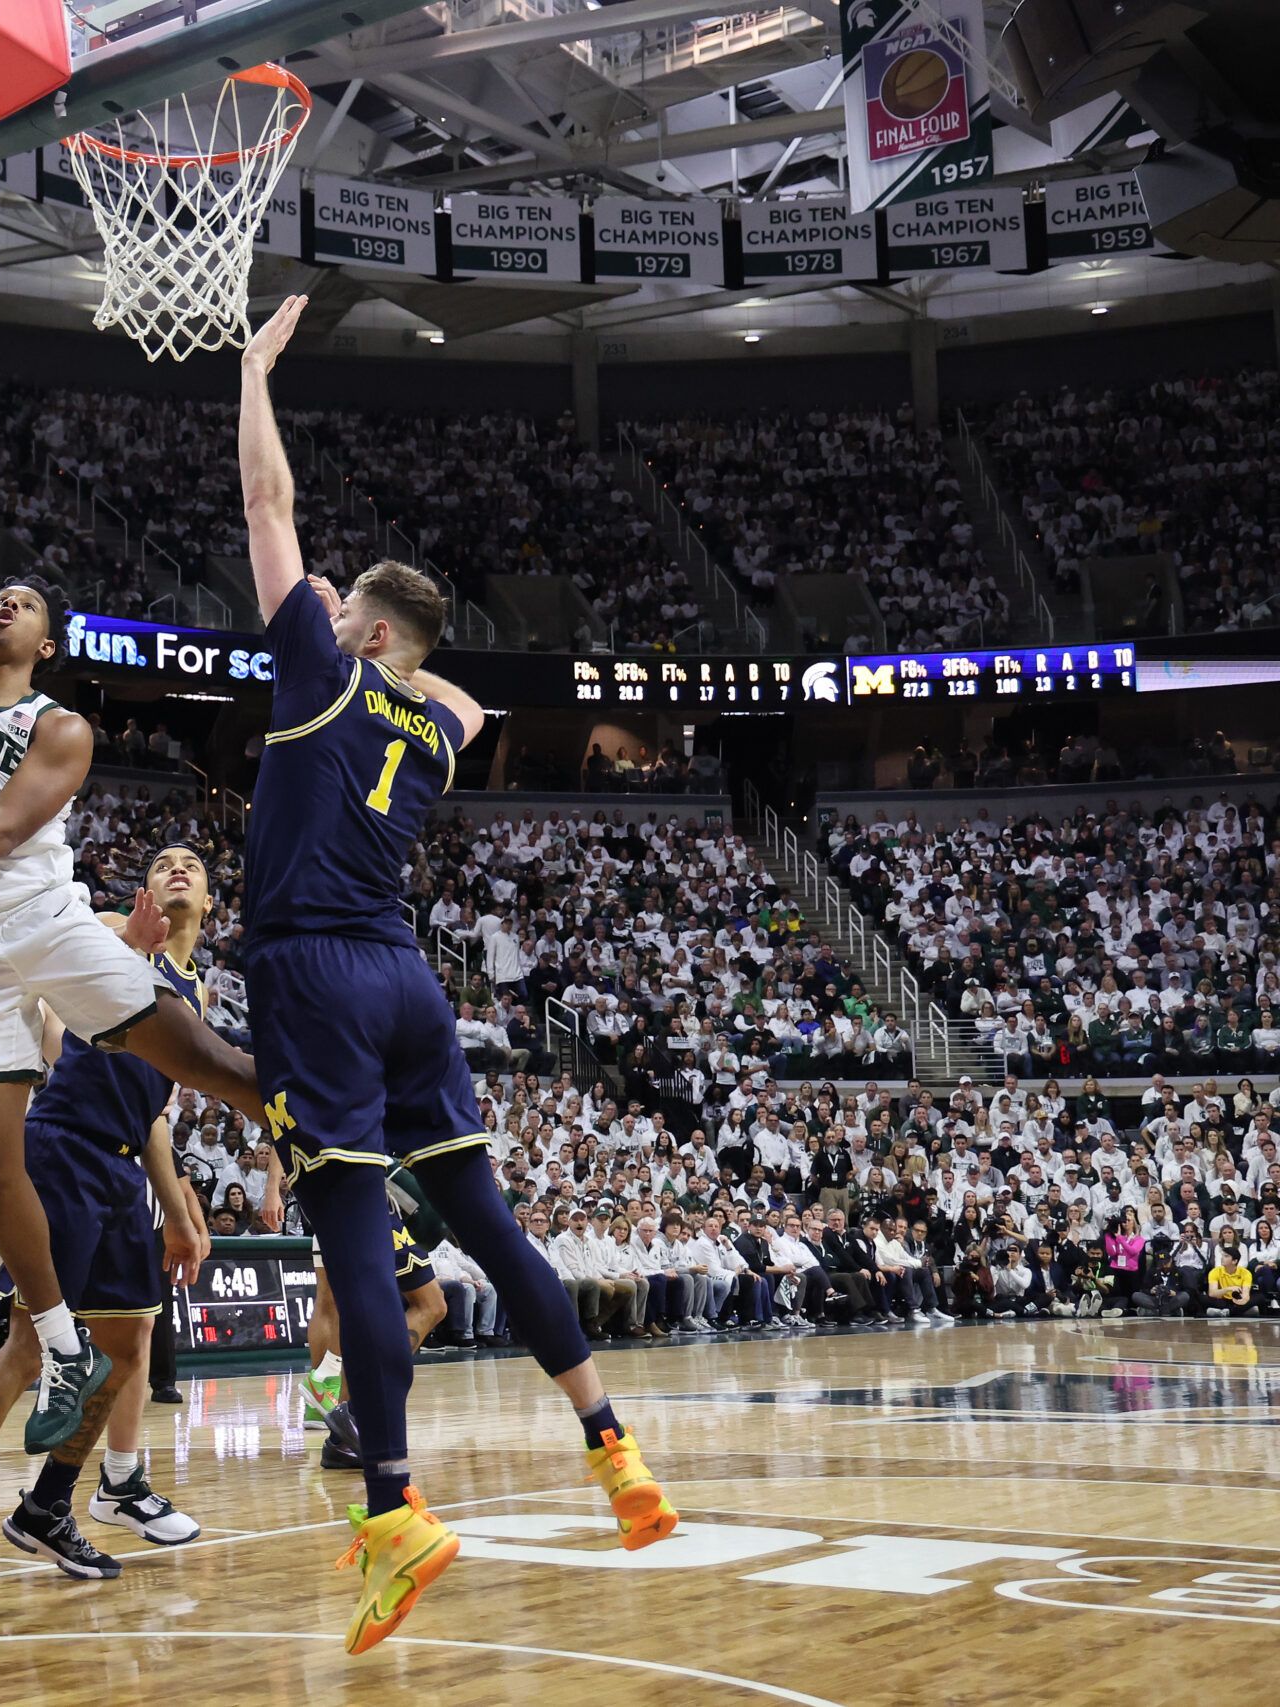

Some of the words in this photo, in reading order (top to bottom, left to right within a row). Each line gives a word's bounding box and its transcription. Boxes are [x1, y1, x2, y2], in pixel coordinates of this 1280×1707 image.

[876, 123, 916, 149] FINAL
[920, 111, 960, 137] FOUR
[931, 156, 989, 186] 1957
[340, 188, 370, 206] BIG
[375, 194, 409, 213] TEN
[1076, 184, 1110, 203] BIG
[1117, 180, 1140, 197] TE
[478, 204, 509, 220] BIG
[515, 205, 552, 221] TEN
[621, 209, 652, 225] BIG
[658, 210, 694, 226] TEN
[770, 208, 802, 224] BIG
[808, 206, 846, 222] TEN
[915, 201, 949, 217] BIG
[955, 198, 993, 214] TEN
[319, 206, 431, 235] CHAMPIONS
[892, 216, 1020, 238] CHAMPIONS
[456, 222, 576, 242] CHAMPIONS
[599, 228, 719, 246] CHAMPIONS
[747, 224, 871, 245] CHAMPIONS
[1091, 228, 1147, 249] 1959
[352, 238, 399, 260] 1998
[490, 250, 542, 269] 1990
[931, 245, 983, 265] 1967
[635, 256, 684, 274] 1979
[784, 253, 835, 272] 1978
[67, 615, 147, 667] fun.
[157, 632, 220, 675] For
[574, 662, 599, 681] FG%
[614, 663, 648, 682] 3FG%
[662, 663, 687, 682] FT%
[701, 664, 710, 681] R
[725, 664, 735, 681] A
[749, 664, 758, 681] B
[773, 664, 790, 681] TO
[901, 660, 927, 678] FG%
[942, 658, 978, 677] 3FG%
[994, 655, 1020, 675] FT%
[1037, 654, 1046, 672] R
[1062, 653, 1072, 671] A
[1088, 651, 1098, 669] B
[1114, 648, 1132, 667] TO
[853, 665, 895, 695] M
[903, 682, 929, 697] 27.3
[948, 680, 976, 695] 12.5
[1066, 675, 1074, 690] 2
[1092, 674, 1099, 688] 2
[1122, 672, 1130, 686] 5
[700, 686, 714, 700] 17
[728, 686, 735, 700] 3
[780, 686, 787, 700] 7
[366, 738, 407, 816] 1
[264, 1090, 297, 1141] M
[392, 1225, 417, 1250] M
[212, 1267, 258, 1297] 4:49
[196, 1327, 203, 1342] 4
[280, 1324, 286, 1338] 3
